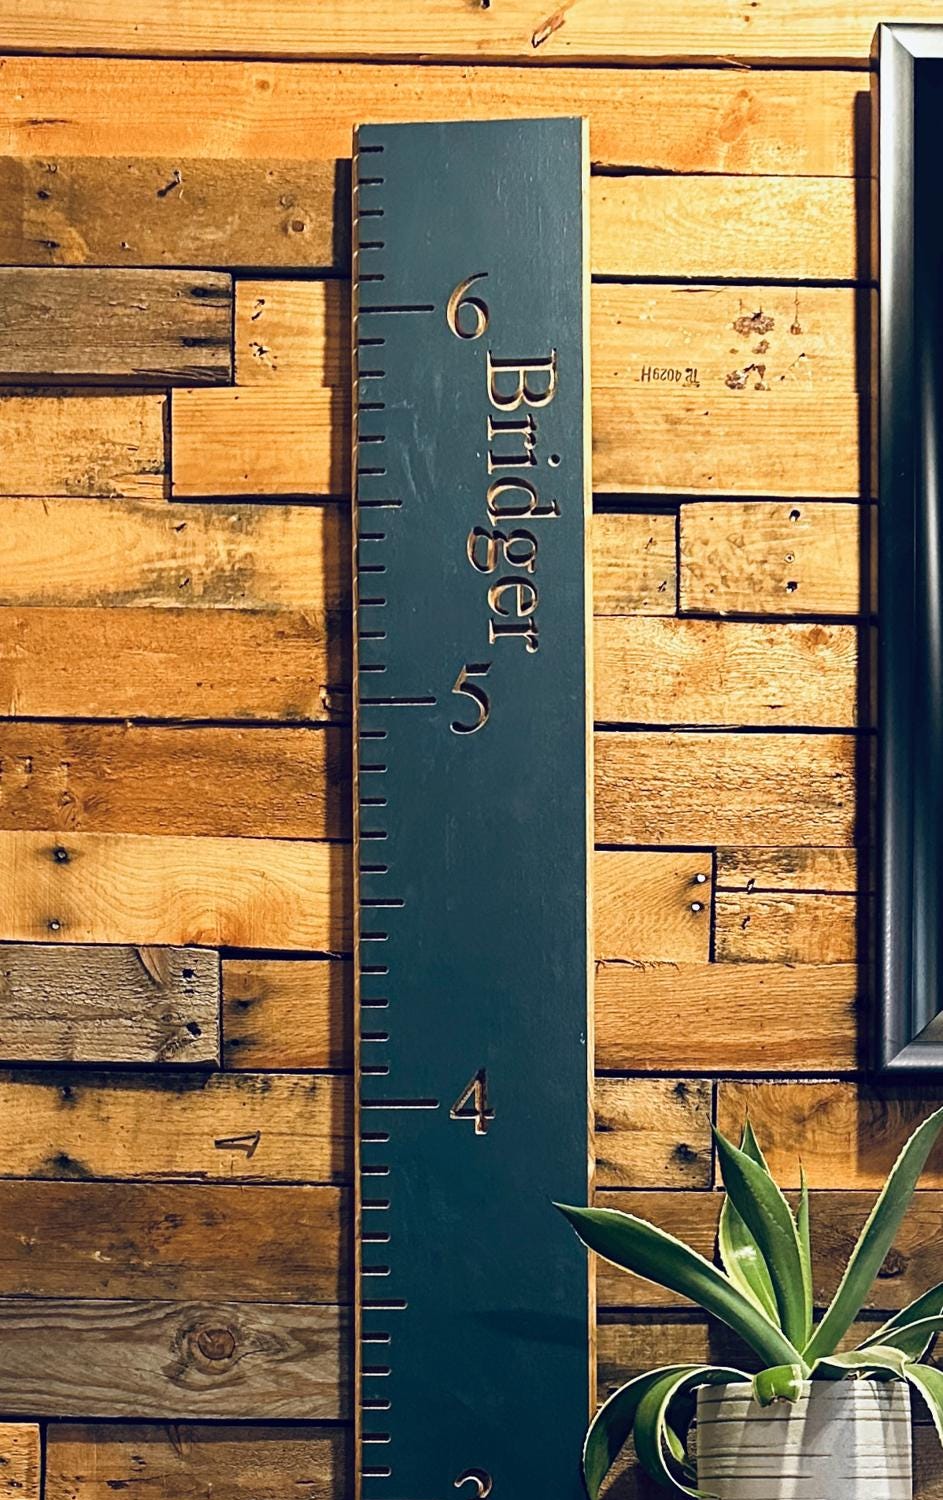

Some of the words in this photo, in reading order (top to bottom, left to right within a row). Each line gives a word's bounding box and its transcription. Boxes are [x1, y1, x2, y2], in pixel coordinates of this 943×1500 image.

[446, 272, 489, 340] 6
[466, 347, 562, 654] Bridger
[449, 661, 492, 735] 5
[449, 1068, 496, 1135] 4
